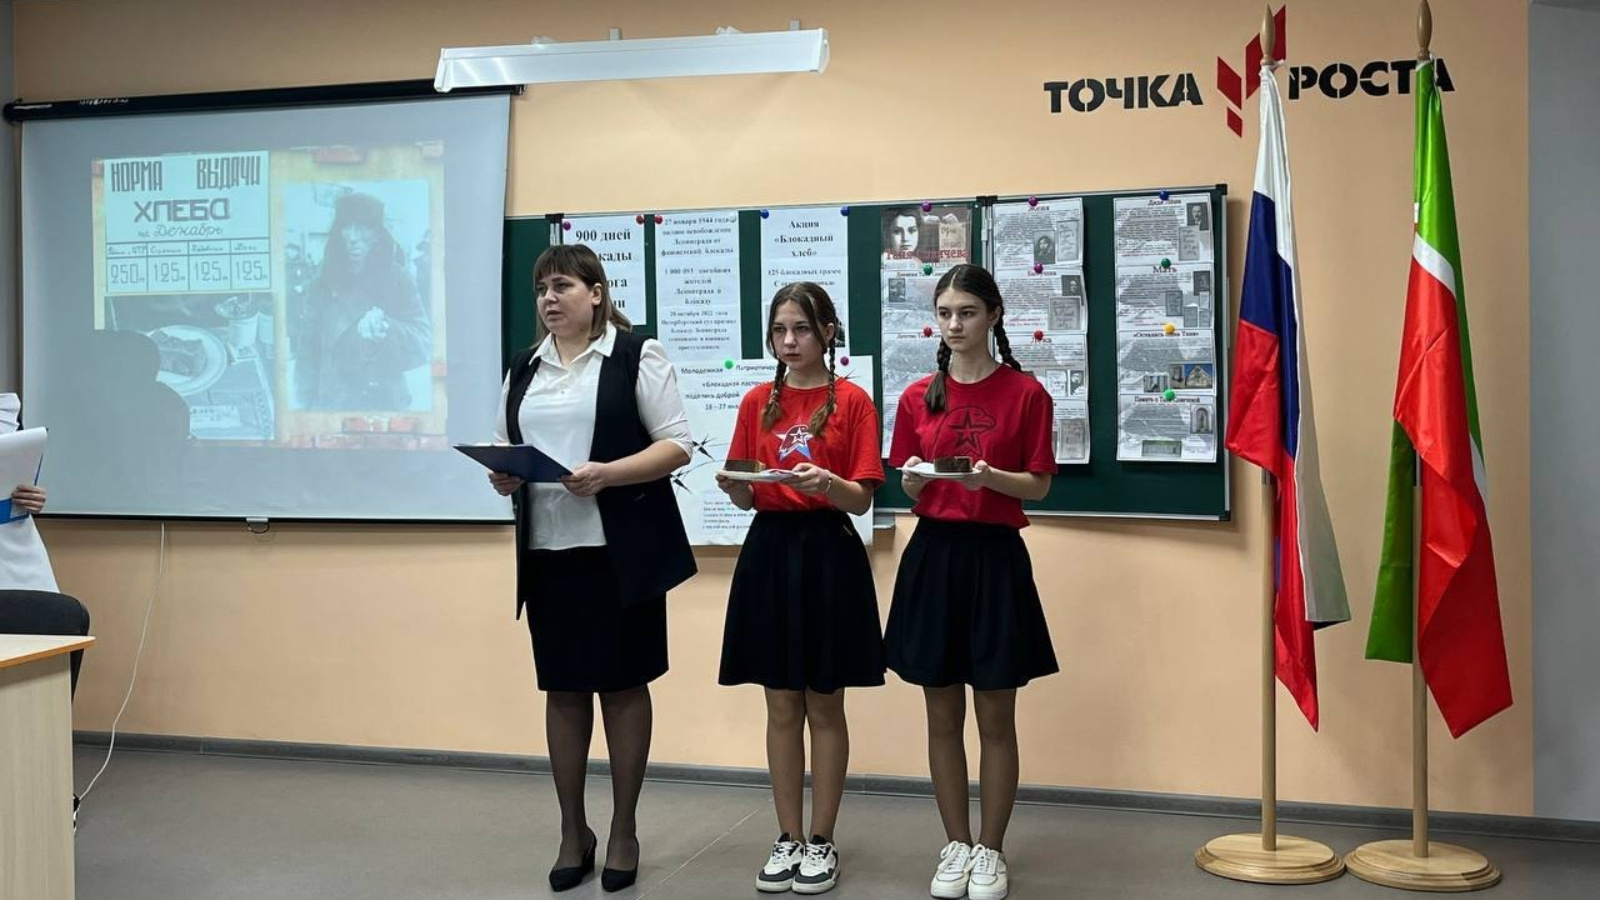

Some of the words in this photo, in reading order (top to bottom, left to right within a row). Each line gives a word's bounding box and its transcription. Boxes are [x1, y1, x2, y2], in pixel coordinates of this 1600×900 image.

[1044, 73, 1204, 113] ТОЧКА
[111, 160, 163, 192] НОРМА
[197, 156, 261, 190] ВЫДАЧИ
[789, 220, 820, 229] Акция
[576, 230, 597, 241] 900
[601, 229, 631, 241] дней
[774, 233, 834, 244] «Блокадный
[599, 252, 632, 262] кады
[792, 247, 818, 257] хлеб»
[606, 279, 628, 288] ога
[716, 391, 740, 400] доброй
